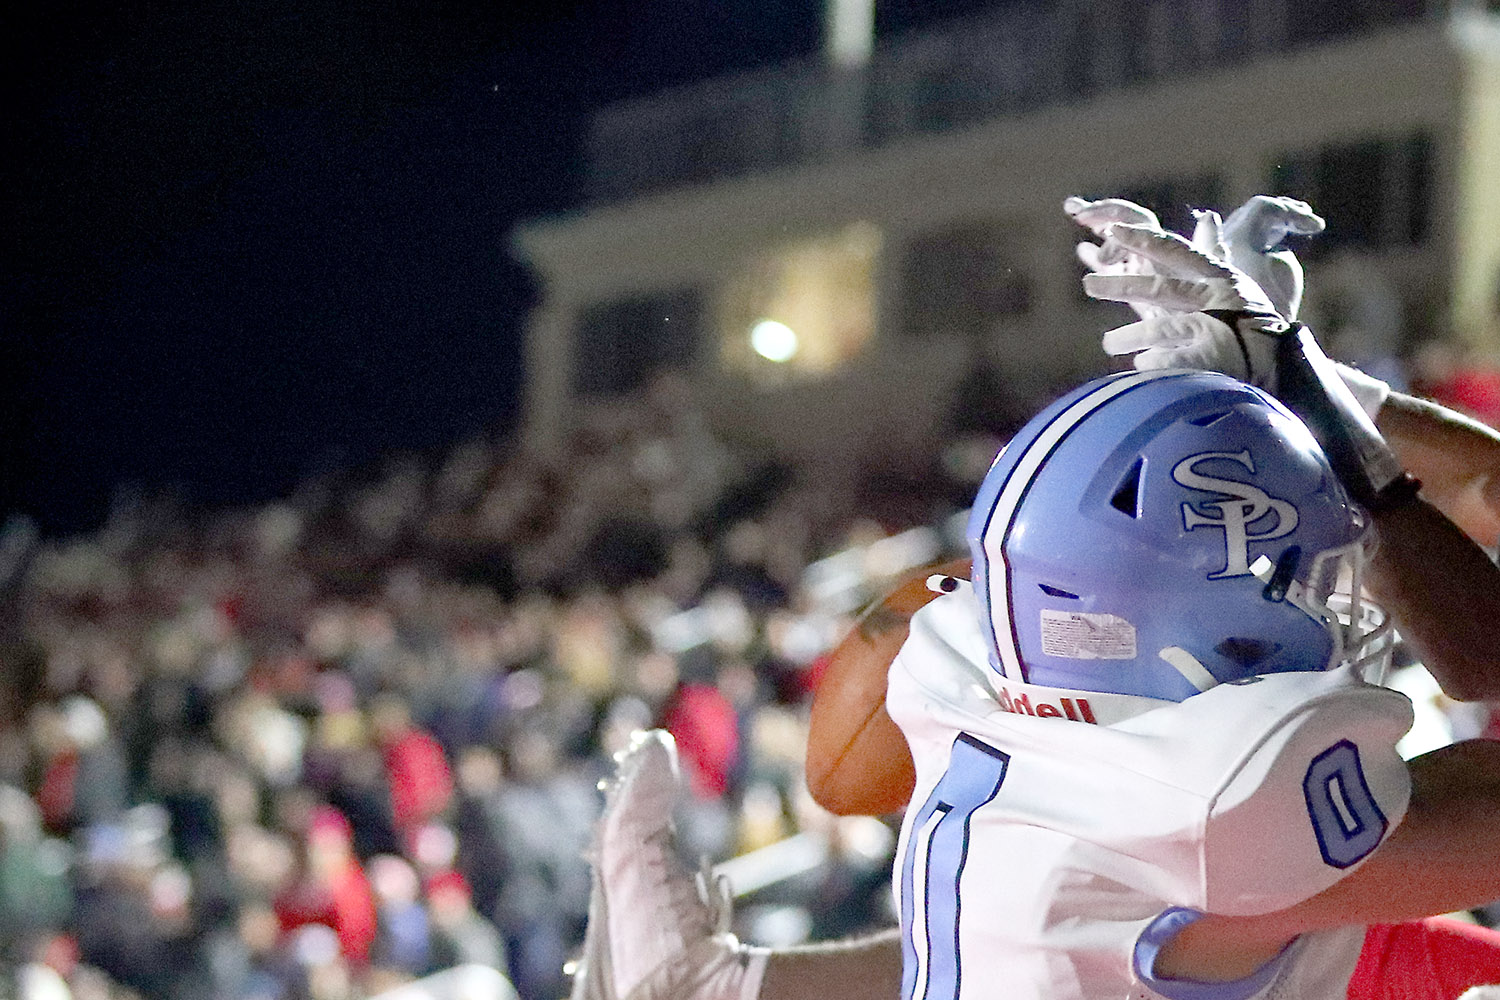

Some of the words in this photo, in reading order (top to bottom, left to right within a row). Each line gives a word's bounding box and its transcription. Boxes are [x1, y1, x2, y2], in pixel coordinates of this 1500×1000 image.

[1171, 448, 1301, 581] SP
[997, 686, 1099, 725] ddell
[1303, 738, 1390, 871] 0
